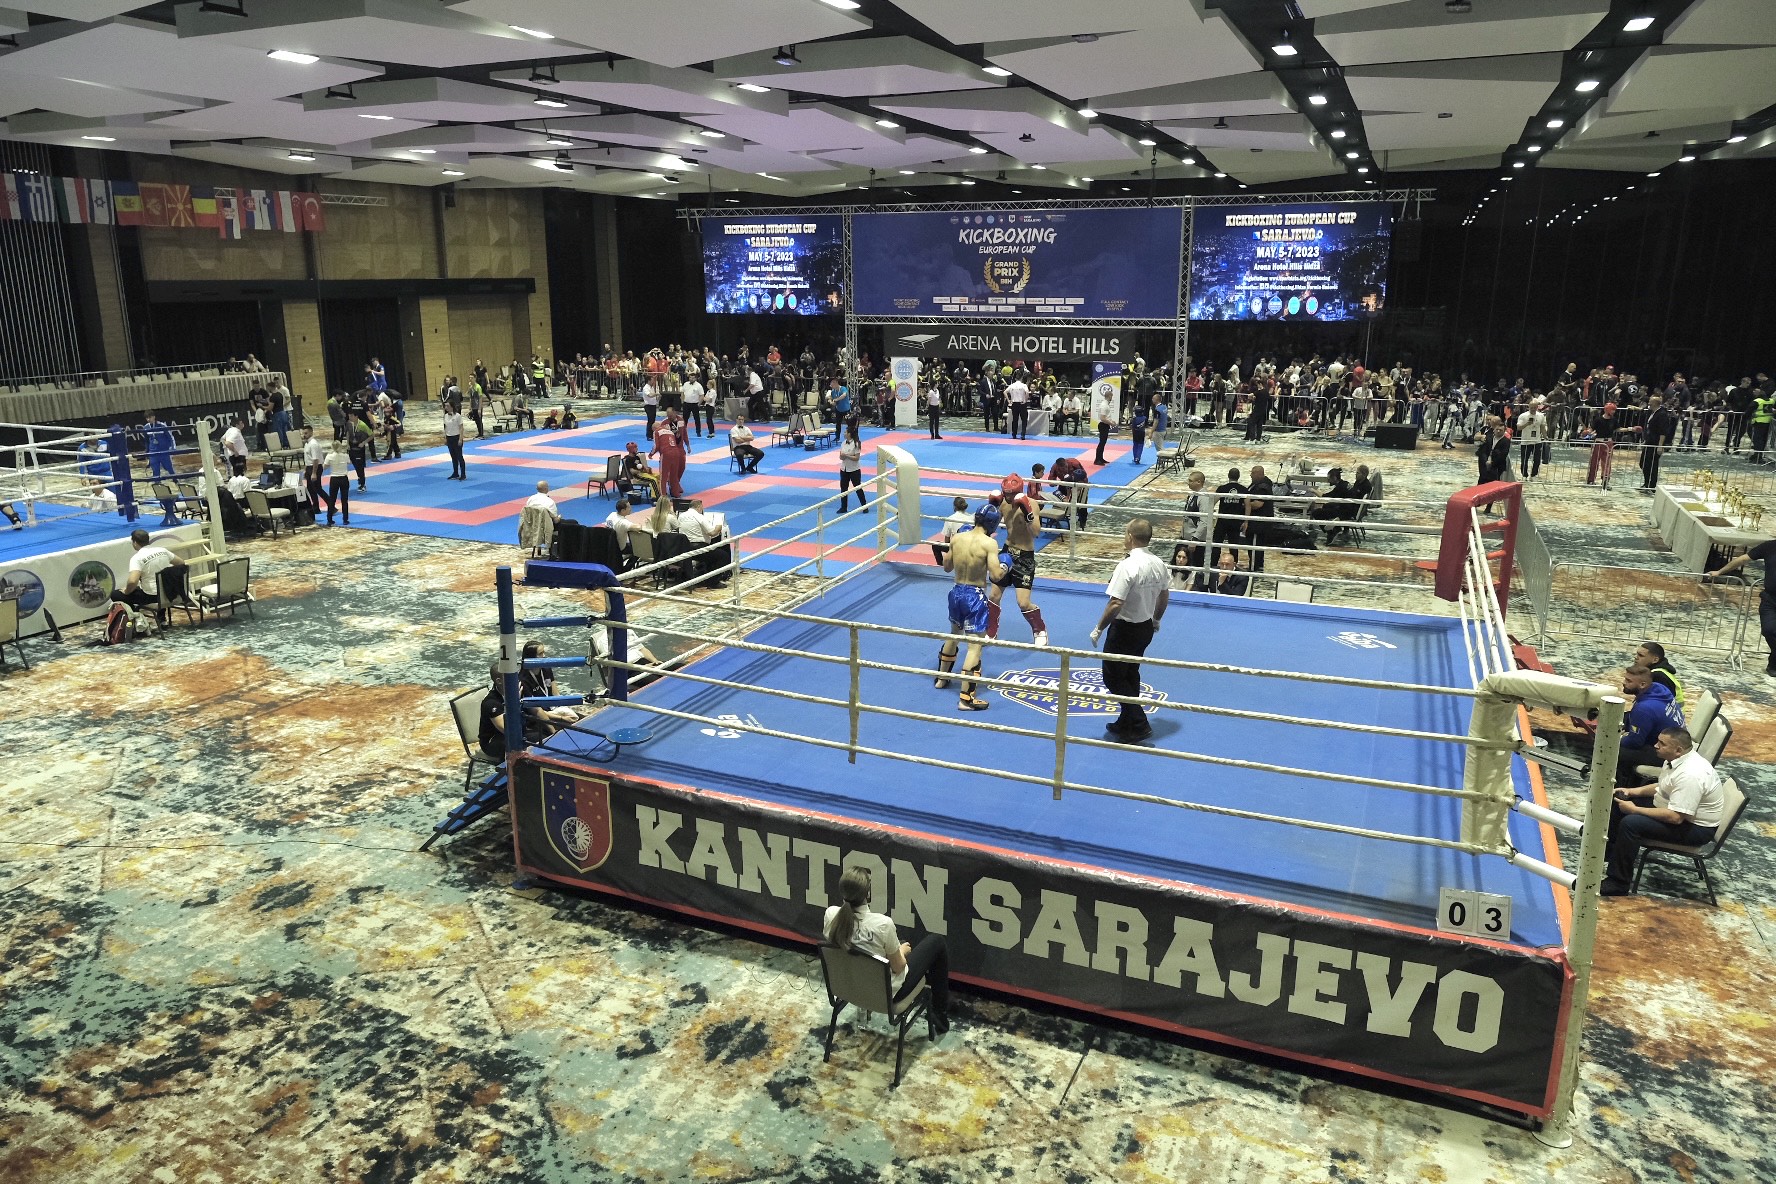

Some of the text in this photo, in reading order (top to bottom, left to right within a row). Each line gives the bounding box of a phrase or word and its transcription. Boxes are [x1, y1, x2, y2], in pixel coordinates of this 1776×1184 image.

[1225, 212, 1357, 227] KICKBOXING EUROPEAN CUP
[724, 224, 817, 235] KICKBOXING EUROPEAN CUP
[959, 228, 1057, 244] KICKBOXING
[1262, 228, 1316, 242] SARAJEVO
[751, 236, 790, 248] SARAJEVO
[748, 252, 762, 262] MAY
[776, 252, 794, 261] 2023
[979, 246, 1036, 254] EUROPEAN CUP
[1256, 246, 1276, 258] MAY
[1296, 246, 1320, 258] 2023
[994, 268, 1019, 276] PRIX
[947, 335, 1120, 355] ARENA HOTEL HILLS
[500, 645, 510, 660] 1
[1016, 692, 1118, 712] SARJEVO
[1449, 902, 1502, 932] 0 3
[636, 804, 1504, 1053] KANTON SARAJEVO
